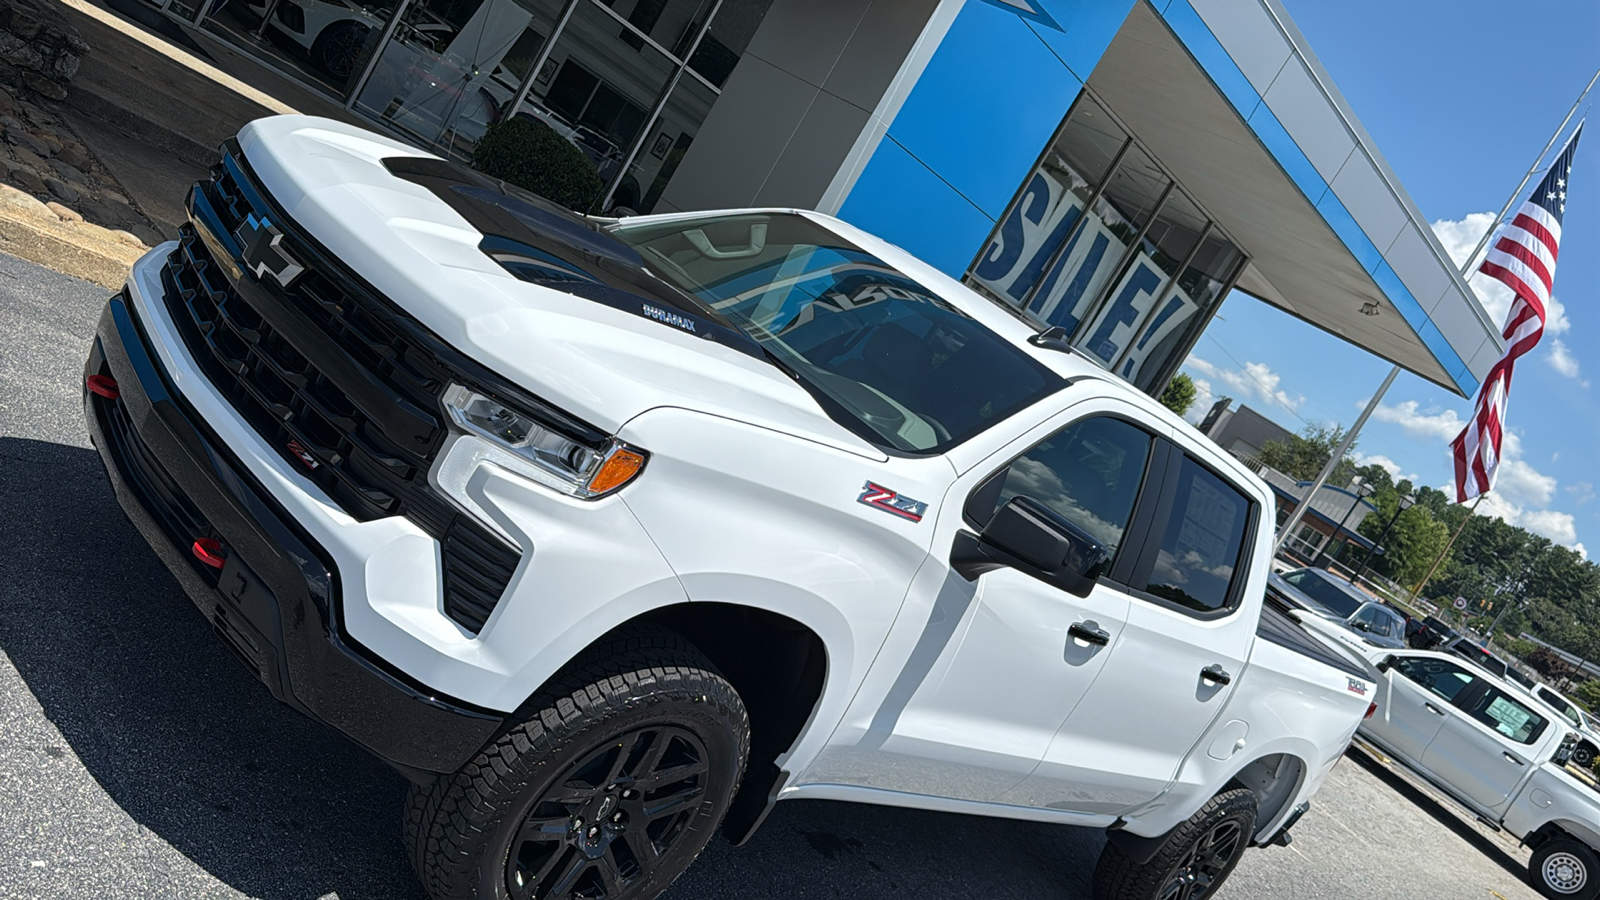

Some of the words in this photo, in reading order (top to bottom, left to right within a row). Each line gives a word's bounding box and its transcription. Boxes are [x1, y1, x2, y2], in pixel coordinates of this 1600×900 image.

[974, 172, 1186, 379] SALE!
[642, 303, 696, 333] DURAMAX
[286, 439, 320, 470] Z71
[856, 479, 929, 524] Z71
